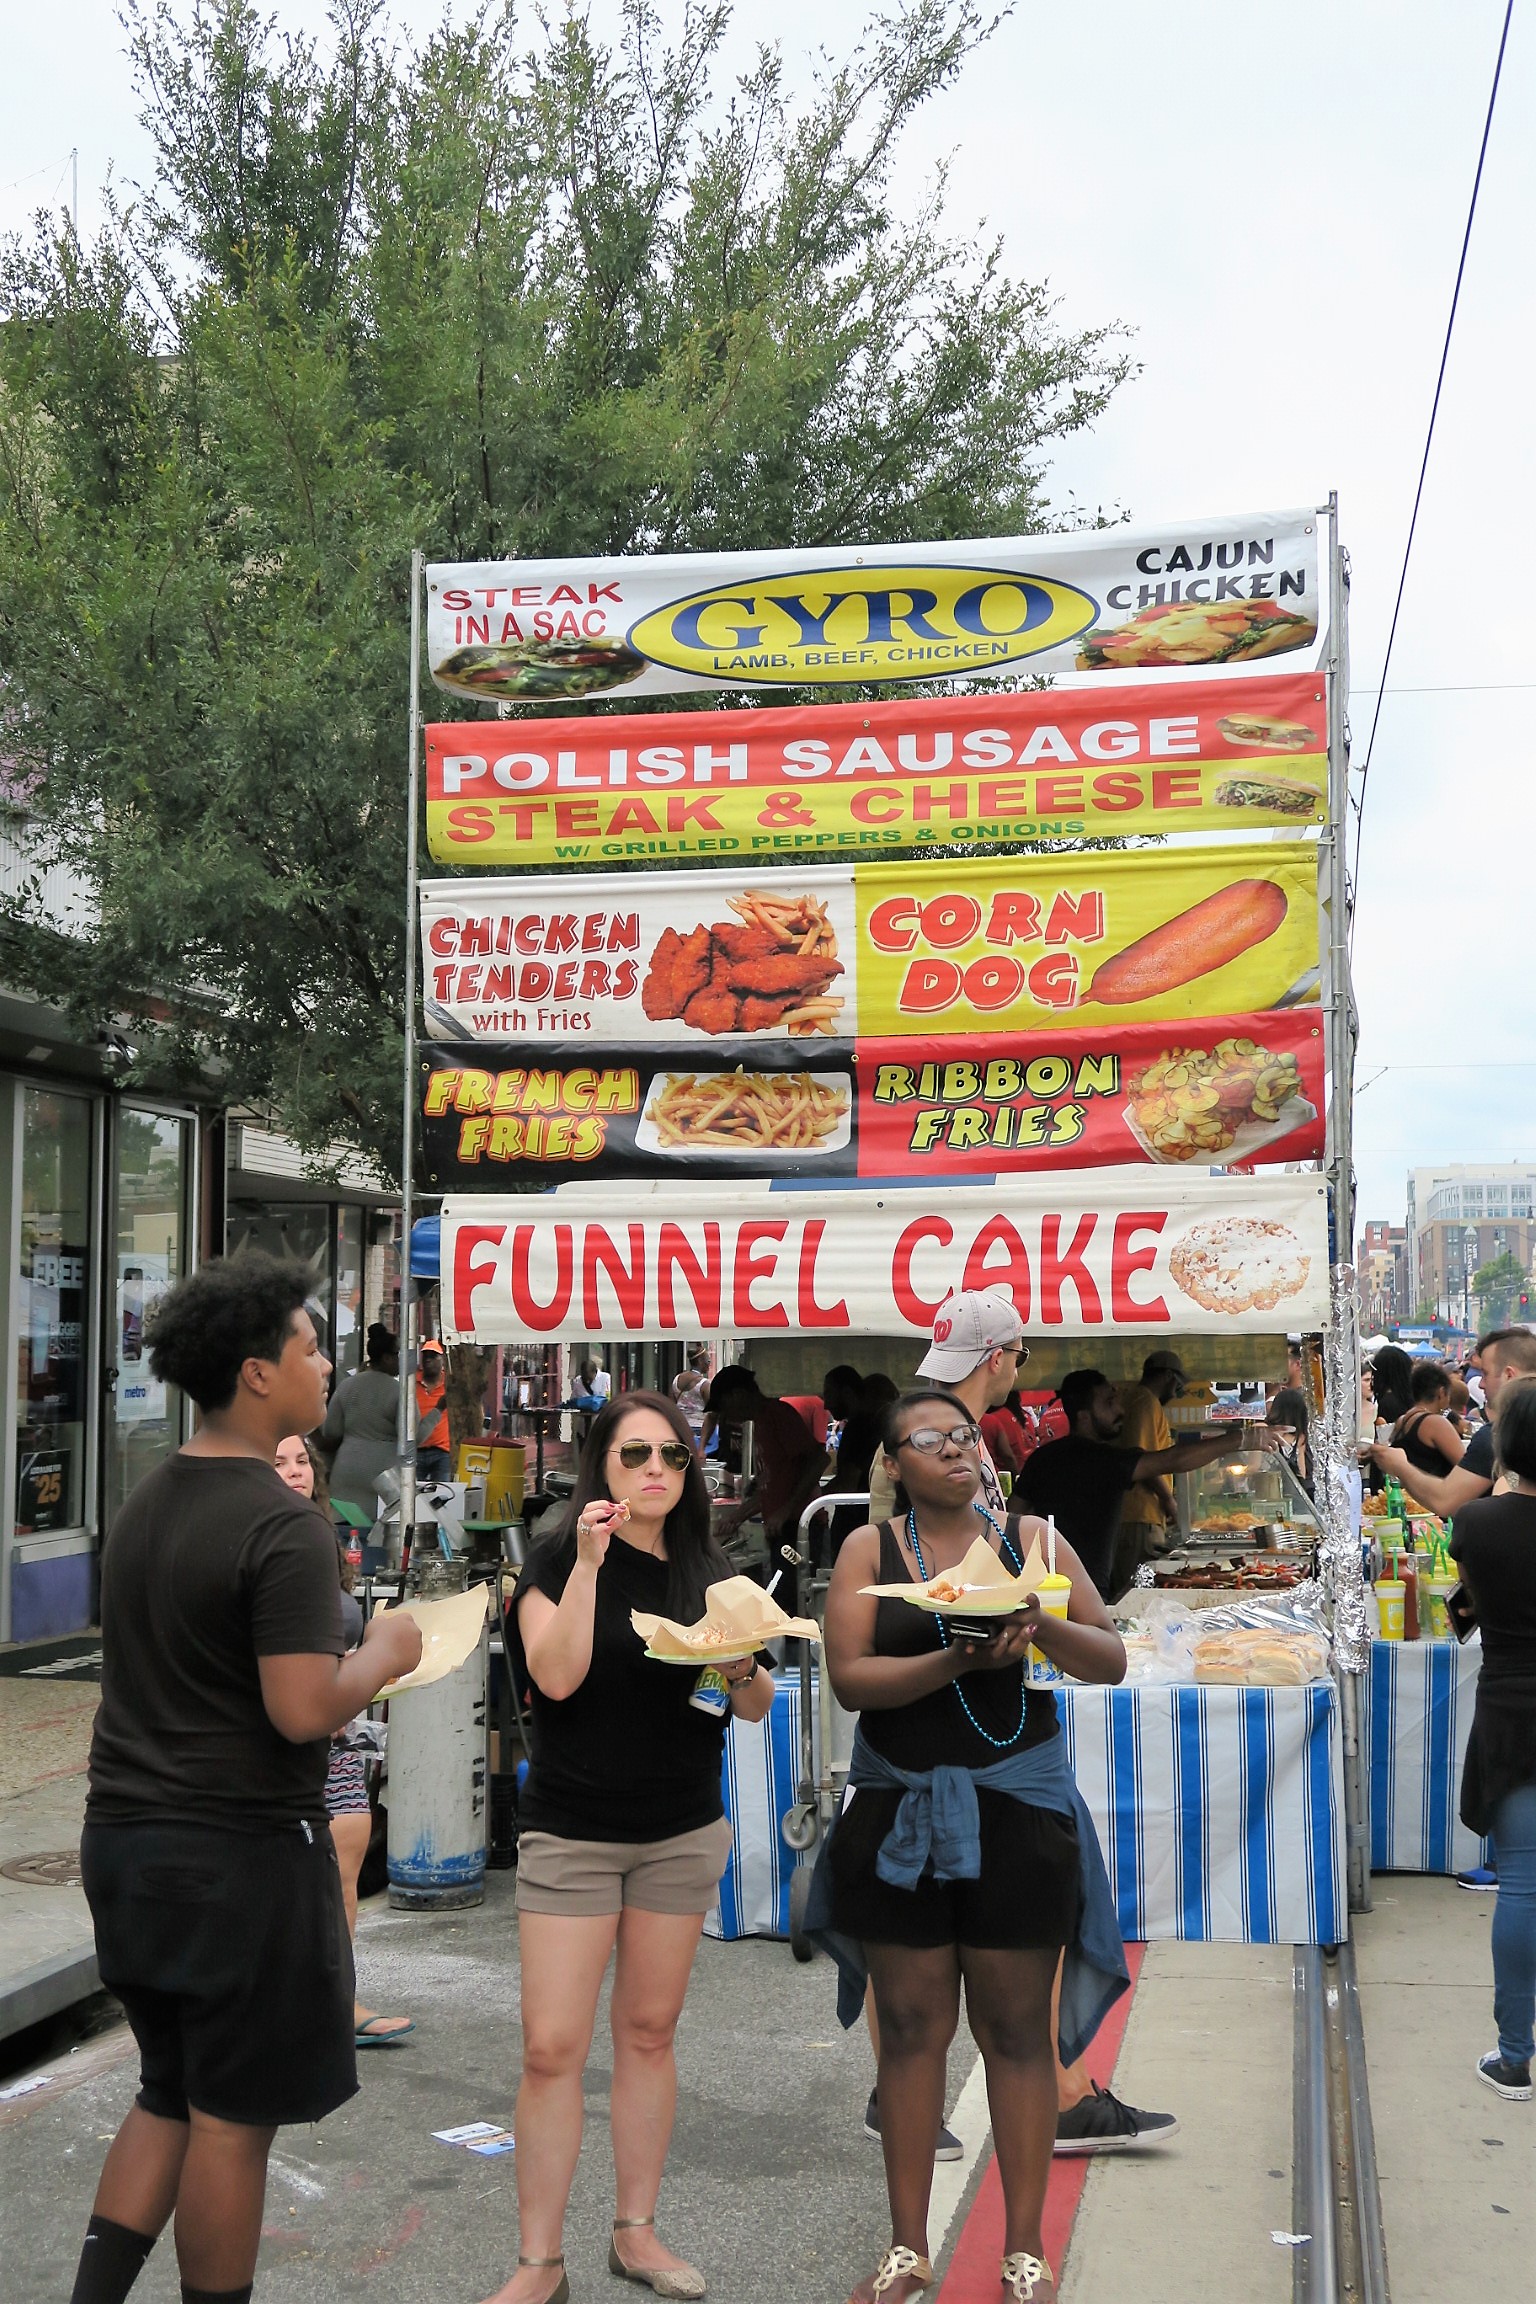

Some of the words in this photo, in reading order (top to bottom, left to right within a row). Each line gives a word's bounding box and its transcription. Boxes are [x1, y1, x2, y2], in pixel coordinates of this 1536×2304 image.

[1136, 538, 1275, 575] CAJUN
[442, 582, 624, 611] STEAK
[1106, 568, 1306, 611] CHICKEN
[455, 614, 490, 645] IN
[501, 612, 525, 643] A
[533, 609, 607, 643] SAC
[670, 580, 1054, 651] GYRO
[713, 654, 795, 671] LAMB,
[805, 649, 879, 666] BEEF,
[888, 641, 1009, 661] CHICKEN
[442, 743, 749, 794] POLISH
[781, 716, 1201, 778] SAUSAGE
[446, 794, 726, 843] STEAK
[756, 791, 817, 828] &
[849, 768, 1203, 825] CHEESE
[555, 844, 591, 858] W/
[601, 836, 739, 856] GRILLED
[751, 829, 902, 849] PEPPERS
[915, 827, 938, 841] &
[961, 820, 1086, 840] ONIONS
[428, 911, 641, 958] CHICKEN
[869, 890, 1104, 952] CORN
[431, 958, 639, 1004] TENDERS
[899, 952, 1079, 1013] DOG
[473, 1008, 528, 1032] with
[537, 1007, 592, 1031] Fries
[423, 1068, 639, 1116] FRENCH
[874, 1054, 1121, 1105] RIBBON
[457, 1114, 609, 1164] FRIES
[910, 1102, 1087, 1153] FRIES
[32, 1254, 84, 1289] FREE
[453, 1219, 851, 1332] FUNNEL
[892, 1211, 1171, 1328] CAKE
[124, 1385, 147, 1398] metro
